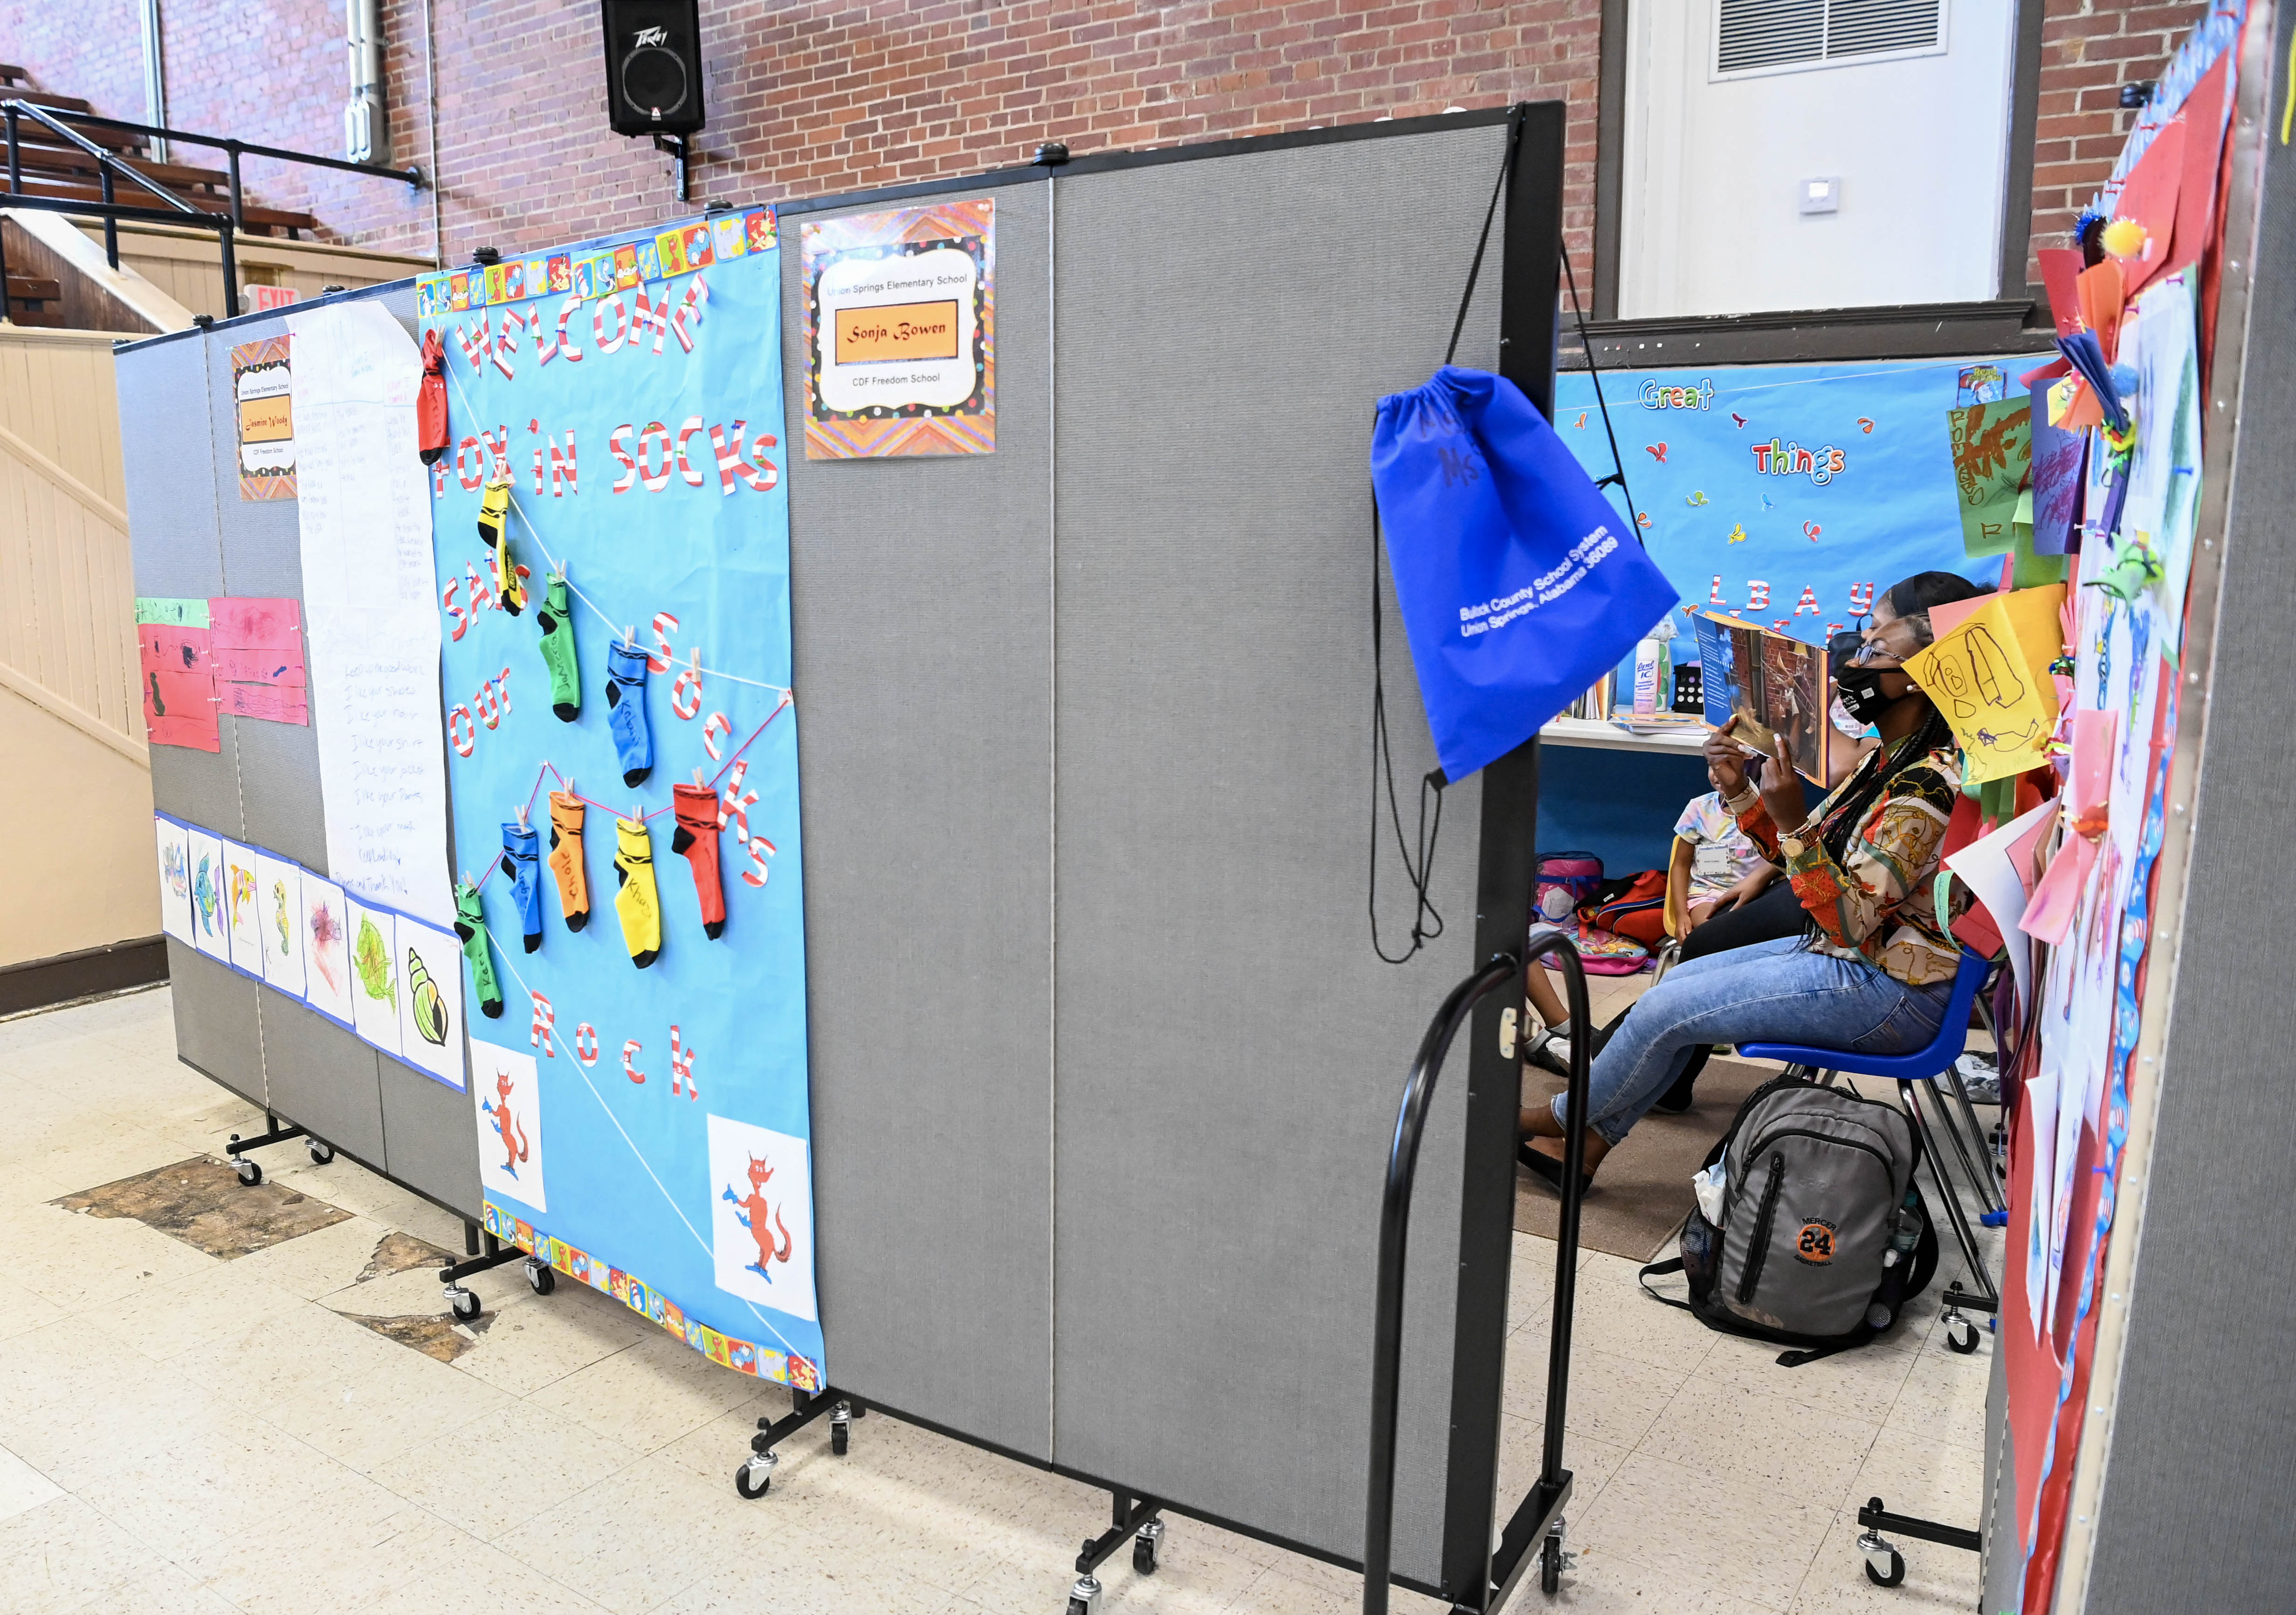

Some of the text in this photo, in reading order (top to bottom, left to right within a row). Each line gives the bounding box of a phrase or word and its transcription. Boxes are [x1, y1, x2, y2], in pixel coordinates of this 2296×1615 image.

[853, 282, 885, 295] Springs
[887, 277, 935, 290] Elementary
[937, 274, 968, 285] School
[257, 286, 295, 311] EXIT
[454, 272, 709, 381] WELCOME
[846, 322, 946, 344] Sonja Bowen
[852, 373, 941, 386] CDF Freedom School
[1638, 377, 1715, 412] Great
[245, 417, 268, 431] Jasmine
[268, 414, 288, 428] Woody
[610, 415, 779, 497] SOCKS
[1751, 437, 1846, 486] Things
[1490, 586, 1533, 612] County
[1533, 556, 1573, 591] School
[1568, 525, 1609, 562] System
[1539, 565, 1588, 605] Alabama
[1582, 535, 1619, 569] 36089
[1637, 660, 1655, 670] Lysol
[530, 989, 698, 1102] ROCK
[1801, 1217, 1837, 1231] MERCER
[1799, 1230, 1832, 1256] 24
[1793, 1254, 1833, 1267] BASKETBALL
